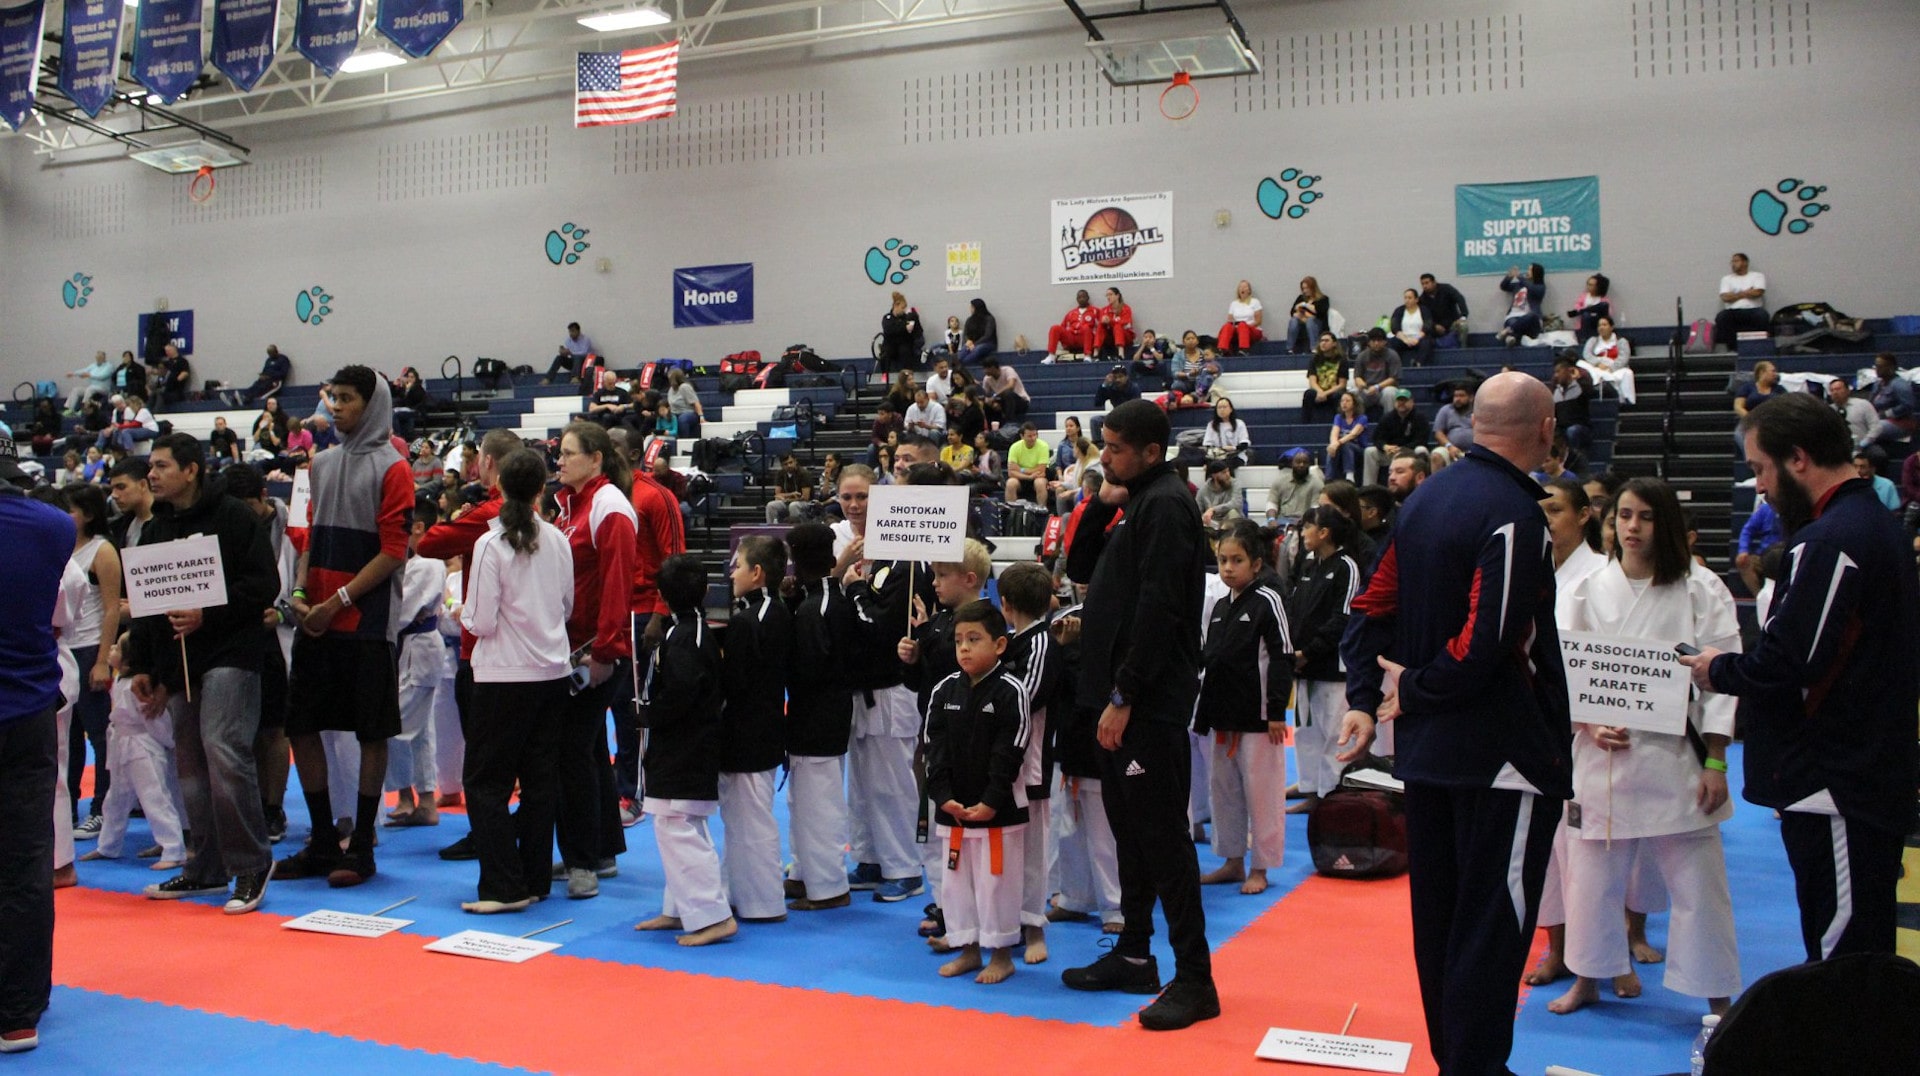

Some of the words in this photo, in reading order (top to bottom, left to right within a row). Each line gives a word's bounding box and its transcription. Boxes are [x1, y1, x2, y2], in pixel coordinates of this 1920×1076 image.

[393, 11, 449, 29] 2015-2016
[1511, 199, 1543, 217] PTA
[1483, 216, 1571, 237] SUPPORTS
[1464, 239, 1497, 257] RHS
[1502, 234, 1592, 255] ATHLETICS
[1058, 270, 1166, 282] www.basketballjunkies.net
[684, 289, 738, 306] Home
[890, 505, 946, 515] SHOTOKAN
[876, 519, 917, 528] KARATE
[919, 520, 957, 530] STUDIO
[880, 533, 934, 544] MESQUITE,
[937, 535, 951, 543] TX
[130, 562, 174, 576] OLYMPIC
[176, 556, 216, 569] KARATE
[144, 574, 178, 586] SPORTS
[180, 569, 215, 581] CENTER
[144, 585, 195, 598] HOUSTON,
[197, 582, 210, 591] TX
[1562, 640, 1580, 651] TX
[1584, 643, 1680, 663] ASSOCIATION
[1568, 658, 1587, 668] OF
[1591, 660, 1672, 679] SHOTOKAN
[1589, 677, 1647, 693] KARATE
[1579, 693, 1631, 710] PLANO,
[1636, 700, 1655, 711] TX
[1276, 1038, 1394, 1057] INTERNATIONAL
[1306, 1048, 1357, 1058] VISION
